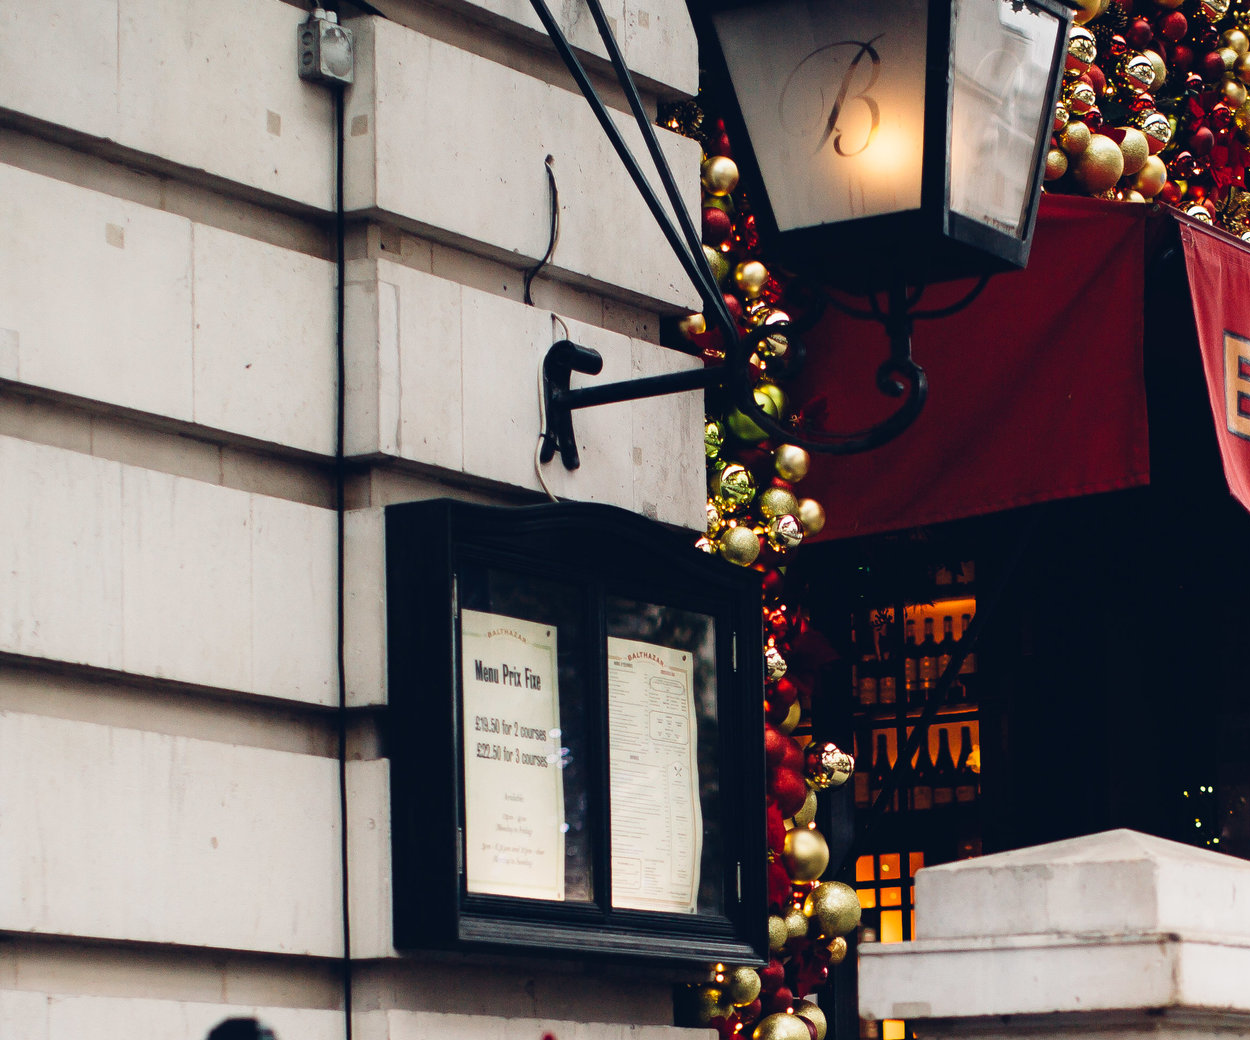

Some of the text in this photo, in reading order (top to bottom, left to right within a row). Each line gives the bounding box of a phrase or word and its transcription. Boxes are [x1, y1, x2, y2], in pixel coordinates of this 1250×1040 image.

[778, 32, 886, 157] B
[487, 628, 528, 643] BALTHAZAR
[627, 651, 664, 666] BALTHAZAR
[475, 659, 542, 691] Menu Prix Fixe
[502, 719, 512, 736] for
[514, 721, 519, 737] 2
[520, 726, 547, 742] courses
[503, 746, 513, 762] for
[515, 748, 520, 764] 3
[522, 753, 548, 768] courses
